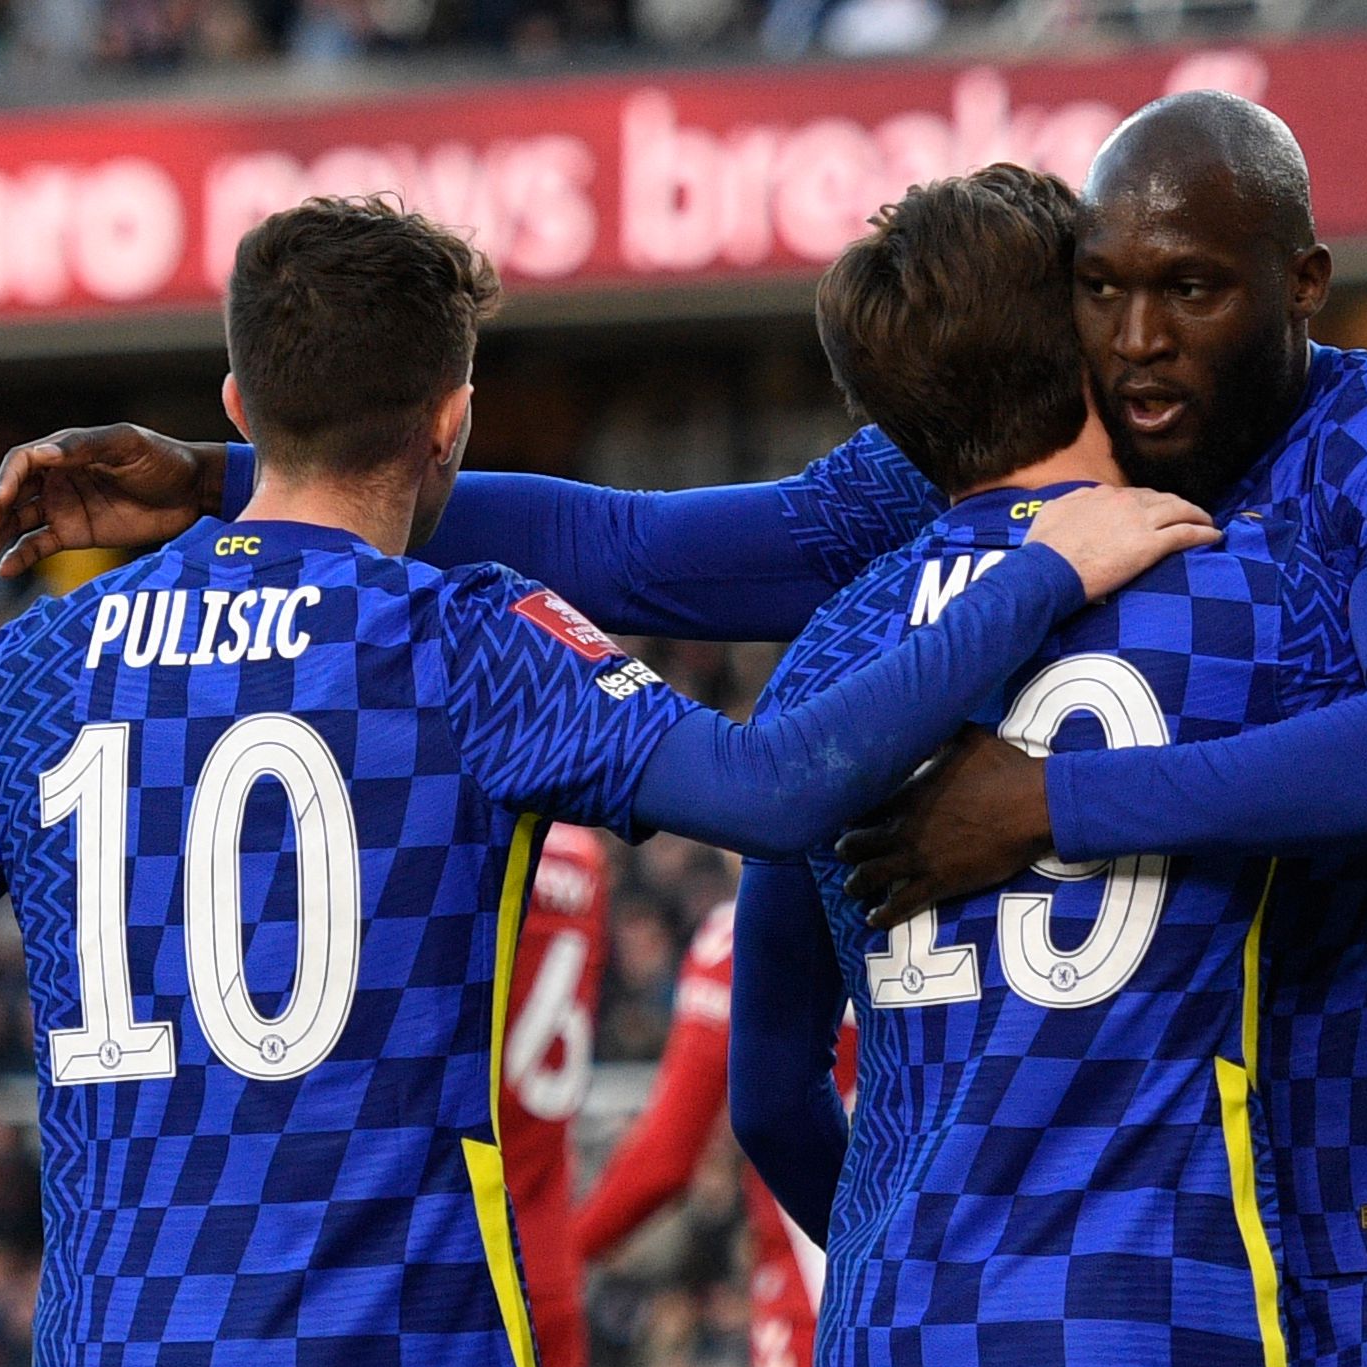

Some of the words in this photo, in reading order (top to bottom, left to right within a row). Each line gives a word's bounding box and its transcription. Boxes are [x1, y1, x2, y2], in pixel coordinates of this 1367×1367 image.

[215, 536, 262, 556] CFC
[85, 585, 322, 670] PULISIC
[38, 711, 362, 1087] 10
[503, 926, 595, 1123] 6
